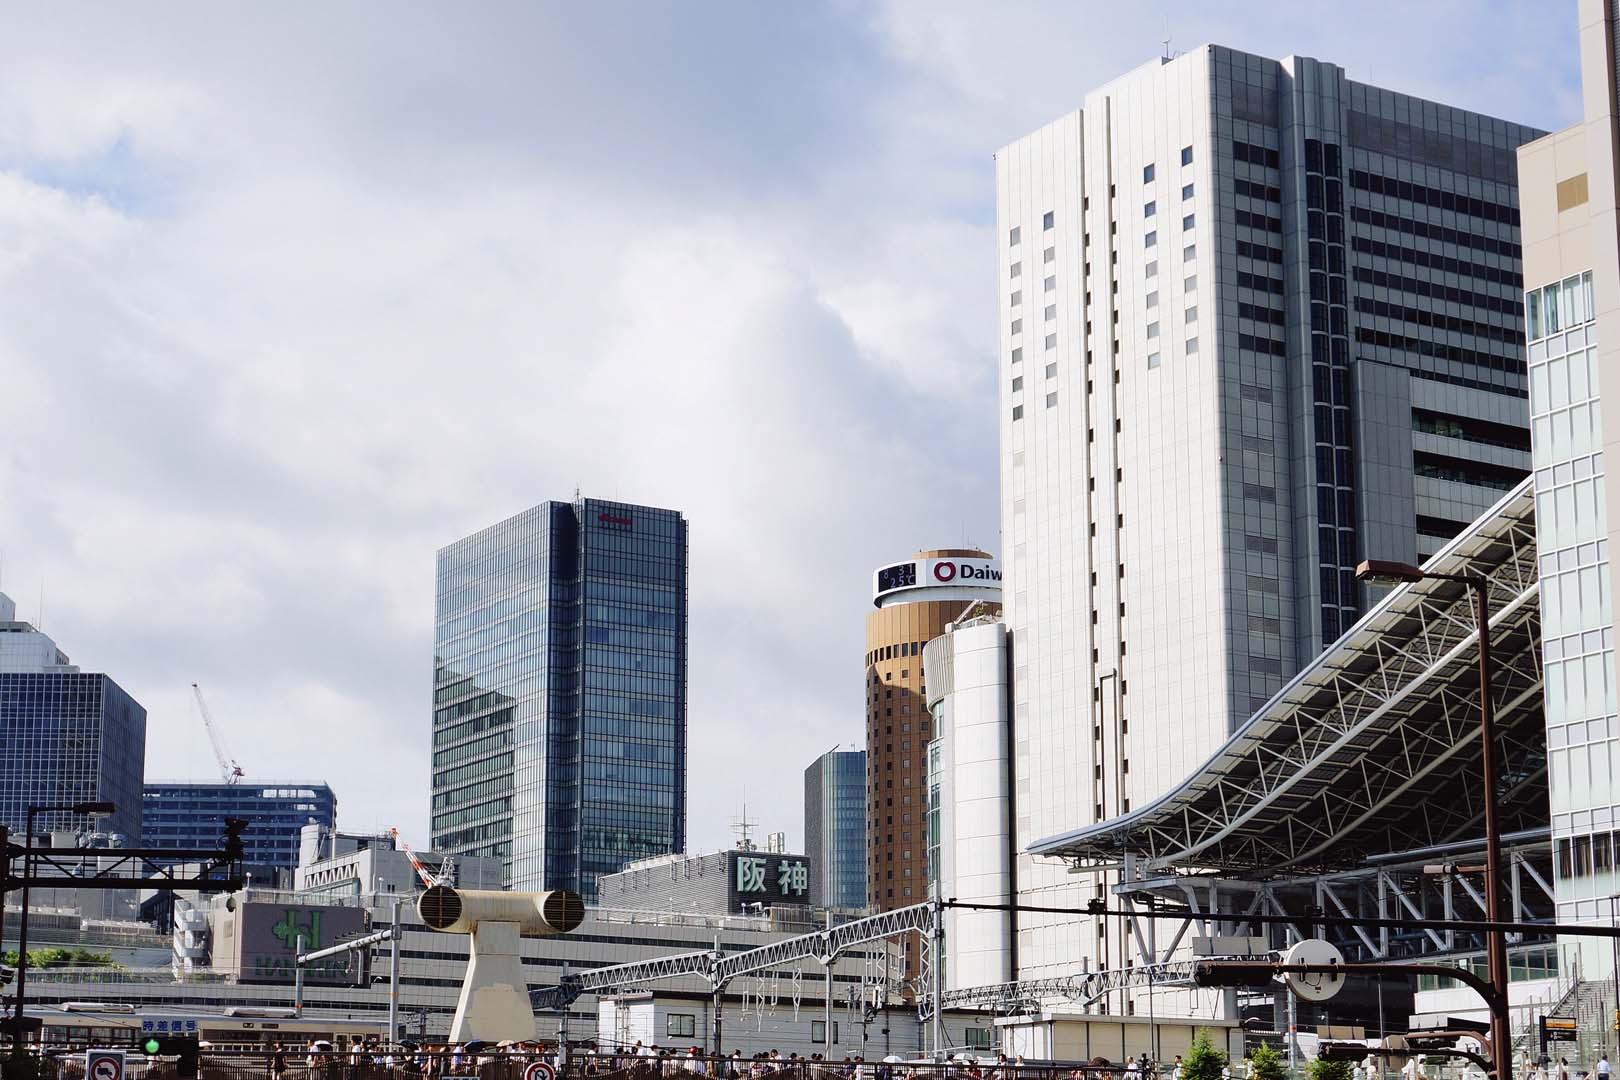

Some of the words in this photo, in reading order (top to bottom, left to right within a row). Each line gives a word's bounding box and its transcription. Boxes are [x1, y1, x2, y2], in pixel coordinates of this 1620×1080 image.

[961, 564, 1002, 581] Daiw
[736, 857, 808, 896] 阪神
[142, 1020, 196, 1032] 時差信号
